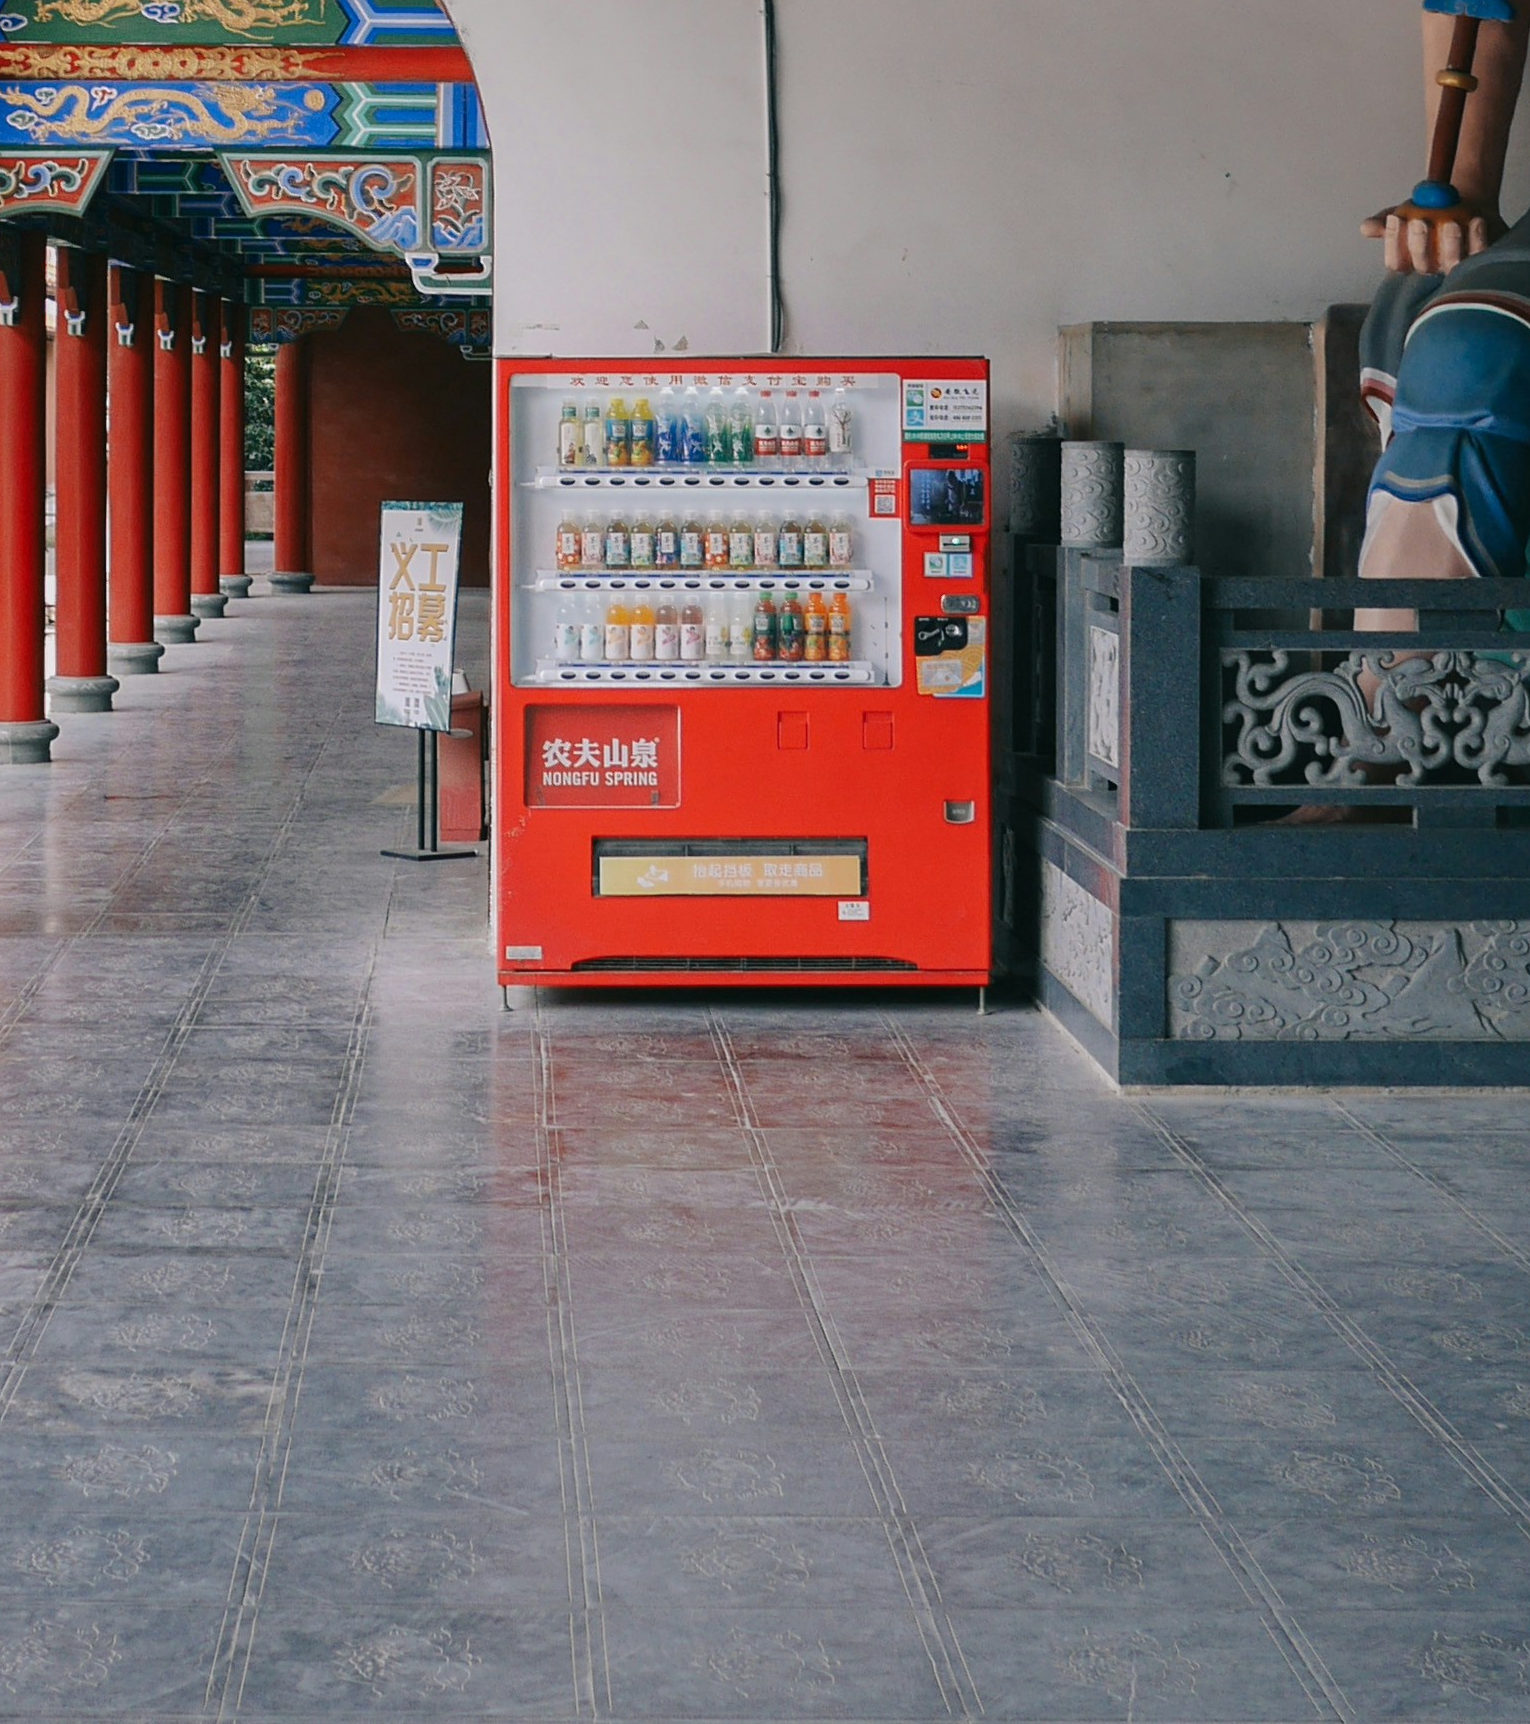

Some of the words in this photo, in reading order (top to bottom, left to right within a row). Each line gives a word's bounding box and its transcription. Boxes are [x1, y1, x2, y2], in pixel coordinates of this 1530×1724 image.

[387, 542, 449, 592] 义工
[388, 591, 446, 642] 招募
[542, 737, 658, 768] 农夫山泉
[543, 771, 600, 786] NONGFU
[605, 771, 658, 786] SPRING
[764, 863, 823, 878] 取走商品
